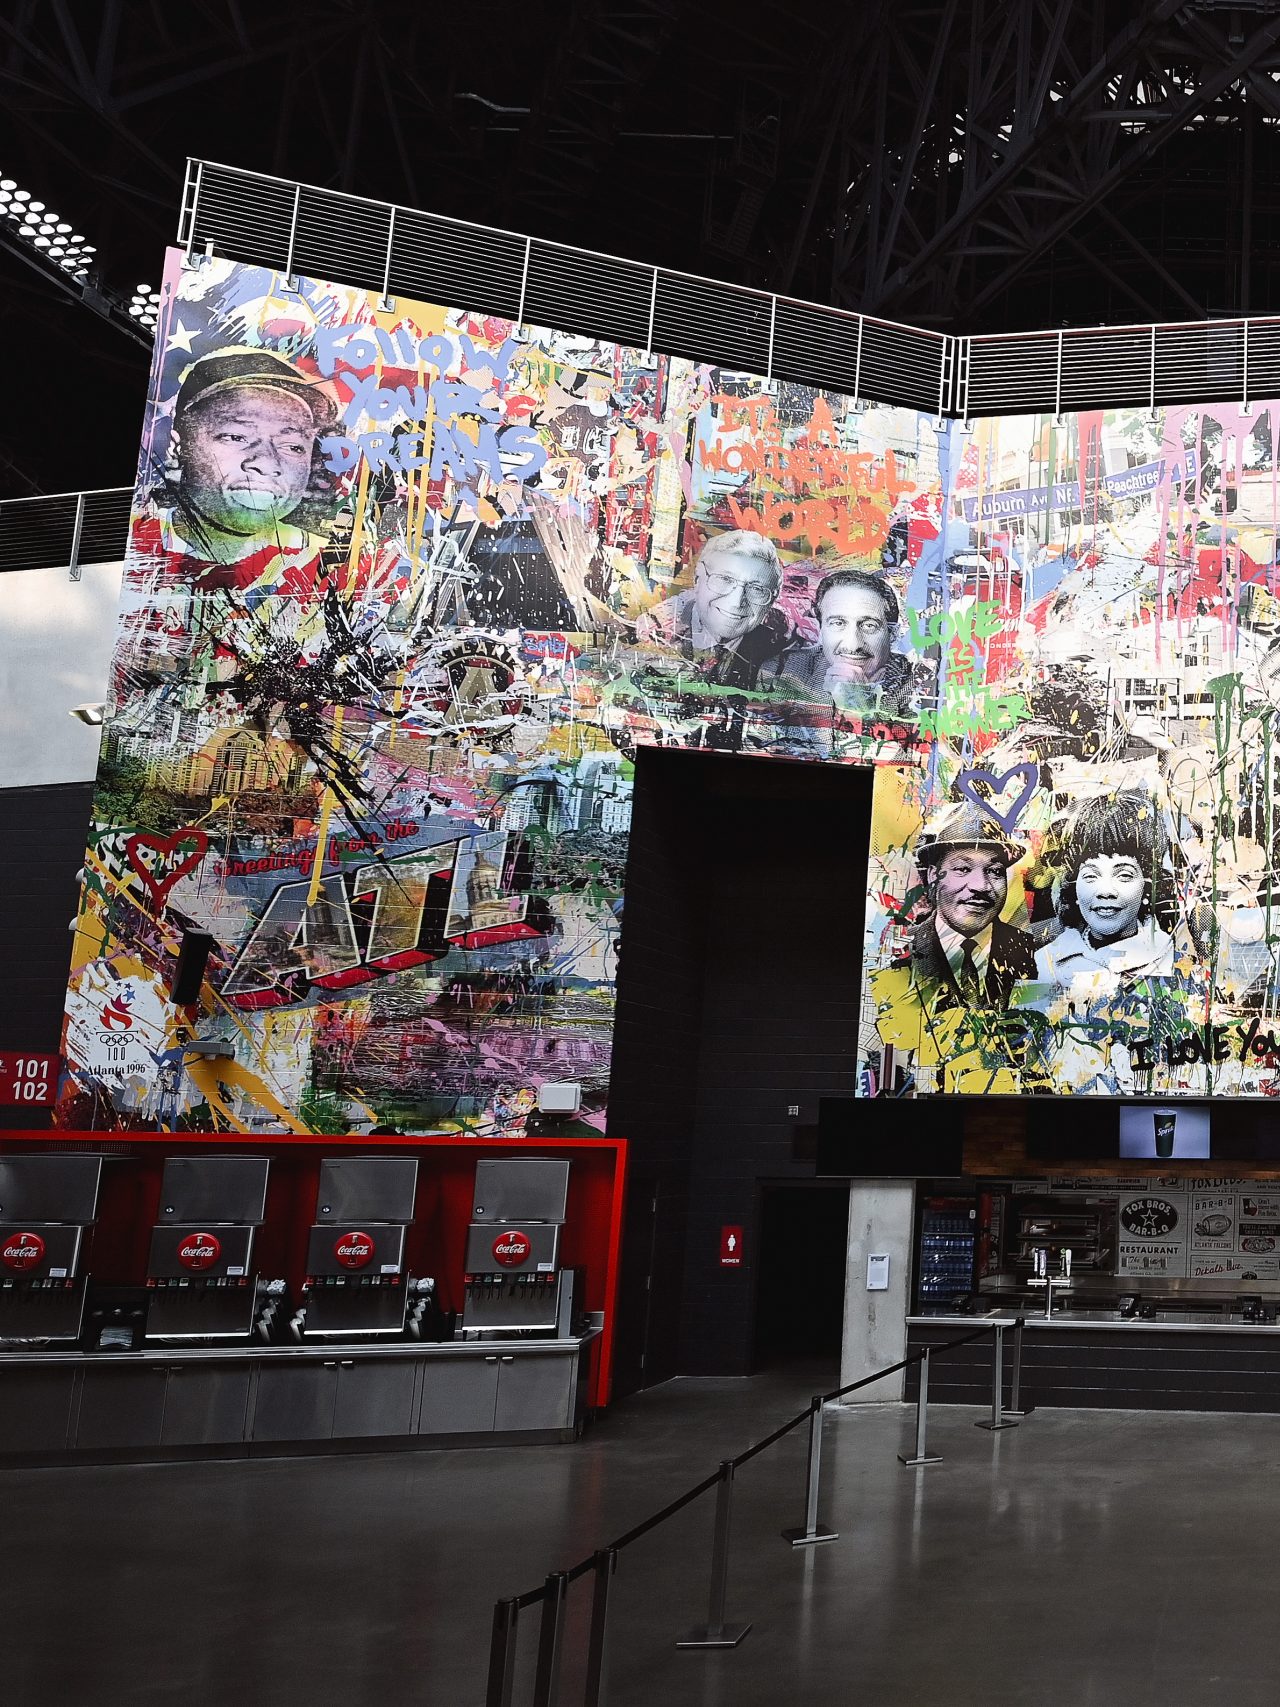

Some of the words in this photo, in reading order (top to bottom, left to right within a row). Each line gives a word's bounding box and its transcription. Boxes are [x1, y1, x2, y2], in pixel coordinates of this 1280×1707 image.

[806, 397, 839, 445] A
[318, 420, 548, 483] DREAMS
[699, 438, 917, 500] WONDERFUL
[1107, 471, 1159, 494] Peachtree
[972, 496, 1026, 518] Auburn
[727, 492, 891, 556] WORLD
[906, 600, 1003, 649] LOVE
[946, 645, 976, 674] IS
[945, 669, 990, 701] THE
[385, 818, 420, 842] the
[221, 829, 542, 1000] ATL
[107, 1046, 126, 1061] 100
[1127, 1040, 1156, 1072] I
[1166, 1024, 1231, 1068] LOVE
[15, 1058, 49, 1079] 101
[87, 1064, 125, 1076] Atlanta
[126, 1064, 146, 1074] 1996
[12, 1081, 48, 1101] 102
[1126, 1198, 1144, 1214] FOX
[1146, 1198, 1172, 1216] BROS.
[1129, 1222, 1170, 1236] BAR-B-Q
[1119, 1246, 1179, 1255] RESTAURANT
